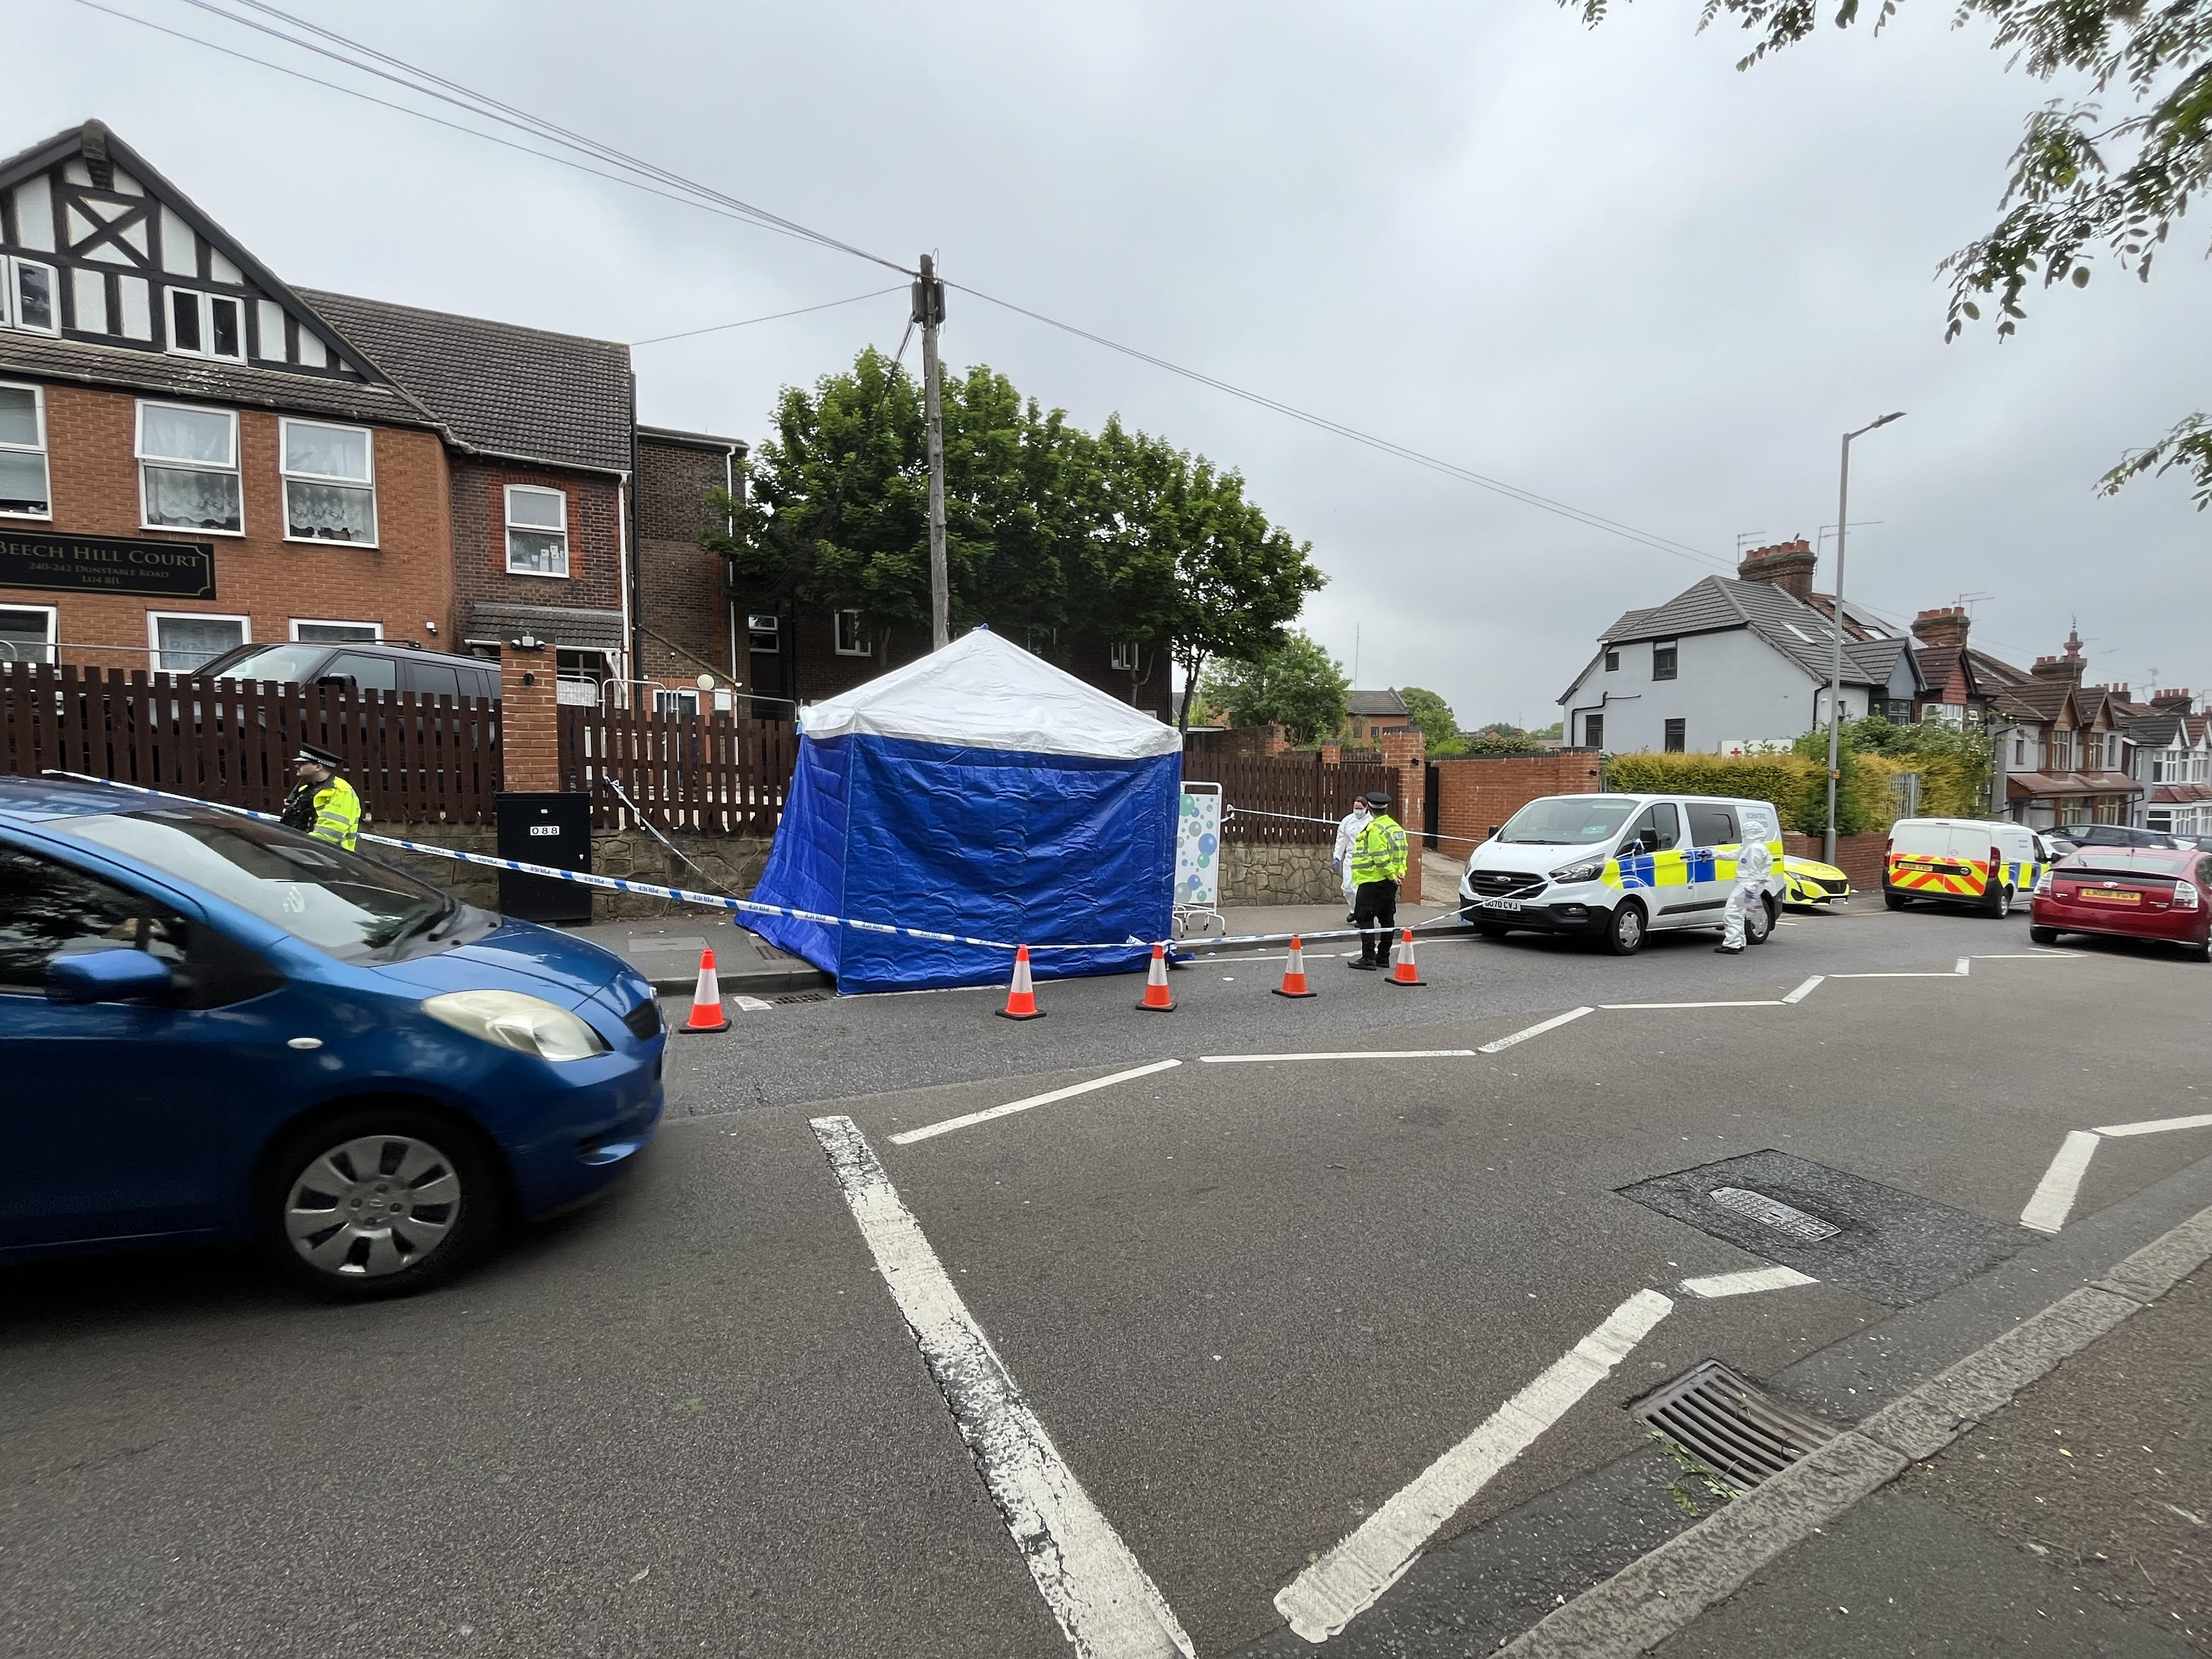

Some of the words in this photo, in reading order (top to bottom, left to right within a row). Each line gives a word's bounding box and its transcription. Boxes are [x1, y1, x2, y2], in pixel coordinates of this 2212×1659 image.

[0, 540, 65, 558] BEECH
[74, 546, 122, 562] HILL
[129, 550, 200, 567] COURT
[29, 562, 72, 572] 240-242
[75, 565, 136, 576] DUNSTABLE
[139, 568, 170, 578] ROAD
[82, 575, 102, 584] LU4
[584, 876, 605, 885] POLICE
[638, 885, 659, 894] POLICE
[692, 894, 714, 904] POLICE
[748, 904, 770, 913] POLICE
[1503, 901, 1517, 910] CVJ
